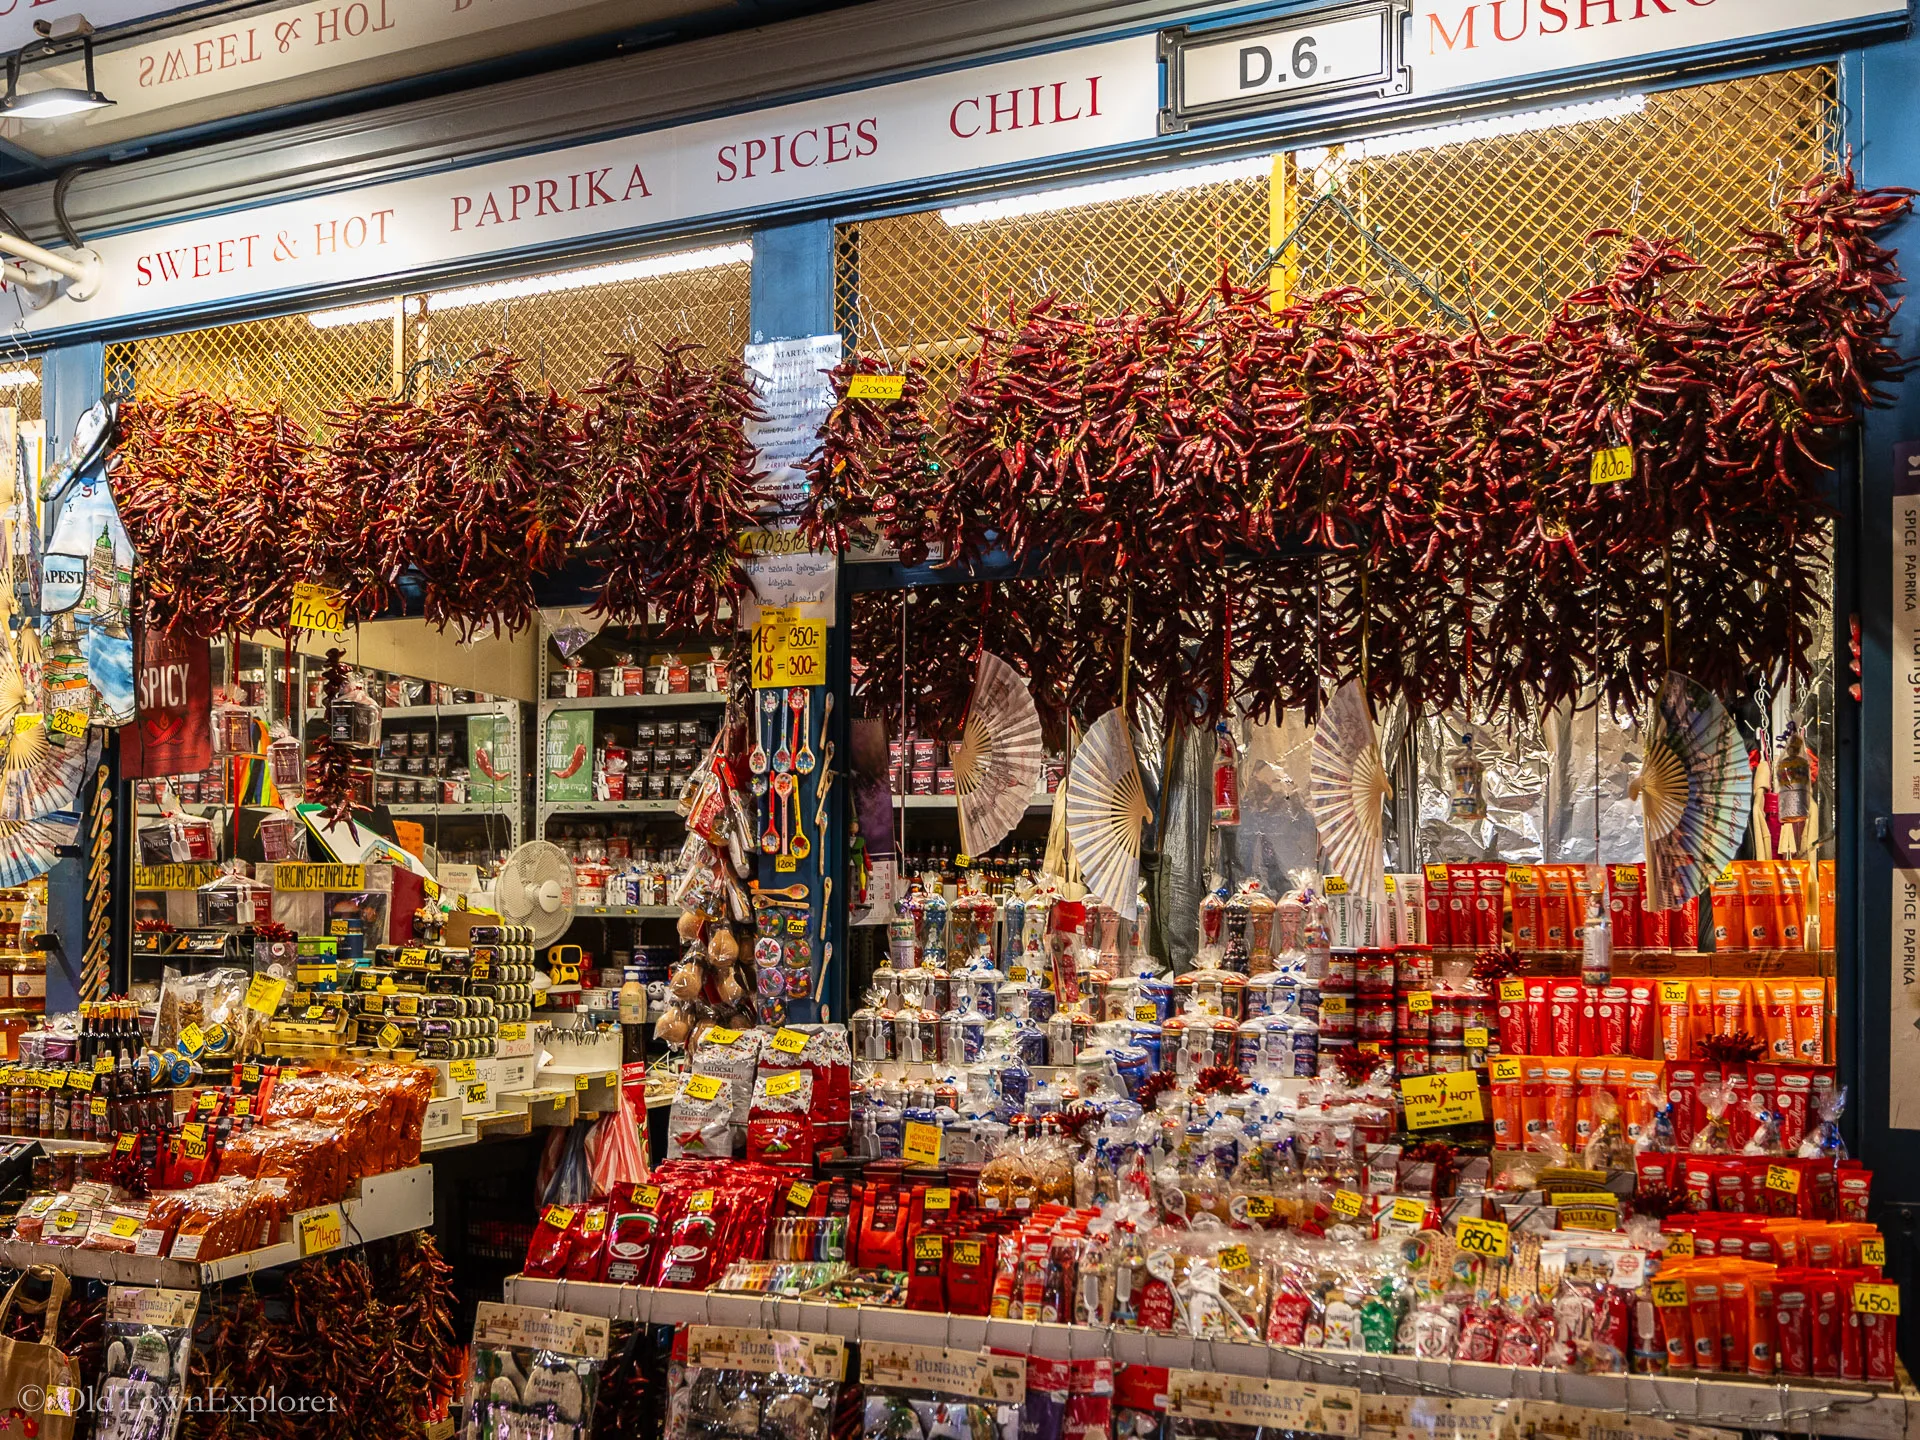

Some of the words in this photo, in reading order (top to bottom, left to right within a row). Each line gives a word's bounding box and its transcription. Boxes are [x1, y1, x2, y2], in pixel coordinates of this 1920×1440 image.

[136, 234, 260, 288] SWEET
[273, 230, 299, 262] &
[315, 209, 395, 256] HOT
[451, 163, 652, 232] PAPRIKA
[717, 117, 879, 184] SPICES
[949, 76, 1102, 139] CHILI
[874, 376, 905, 384] PAPRIKA
[1593, 461, 1629, 480] 1800.-
[1905, 510, 1917, 547] SPICE
[297, 584, 314, 592] HOT
[1905, 555, 1917, 612] PAPRIKA
[139, 663, 189, 710] SPICY
[1477, 869, 1504, 878] XL
[1748, 867, 1774, 875] XL
[1904, 883, 1916, 920] SPICE
[1904, 929, 1916, 986] PAPRIKA
[1405, 1094, 1437, 1105] EXTRA
[1449, 1090, 1476, 1101] HOT
[1563, 1212, 1607, 1223] GULYÁS
[1462, 1229, 1502, 1252] 850.-
[1859, 1293, 1897, 1312] 450.-
[524, 1320, 574, 1339] HUNGARY
[915, 1359, 977, 1379] HUNGARY
[1229, 1390, 1305, 1411] HUNGARY
